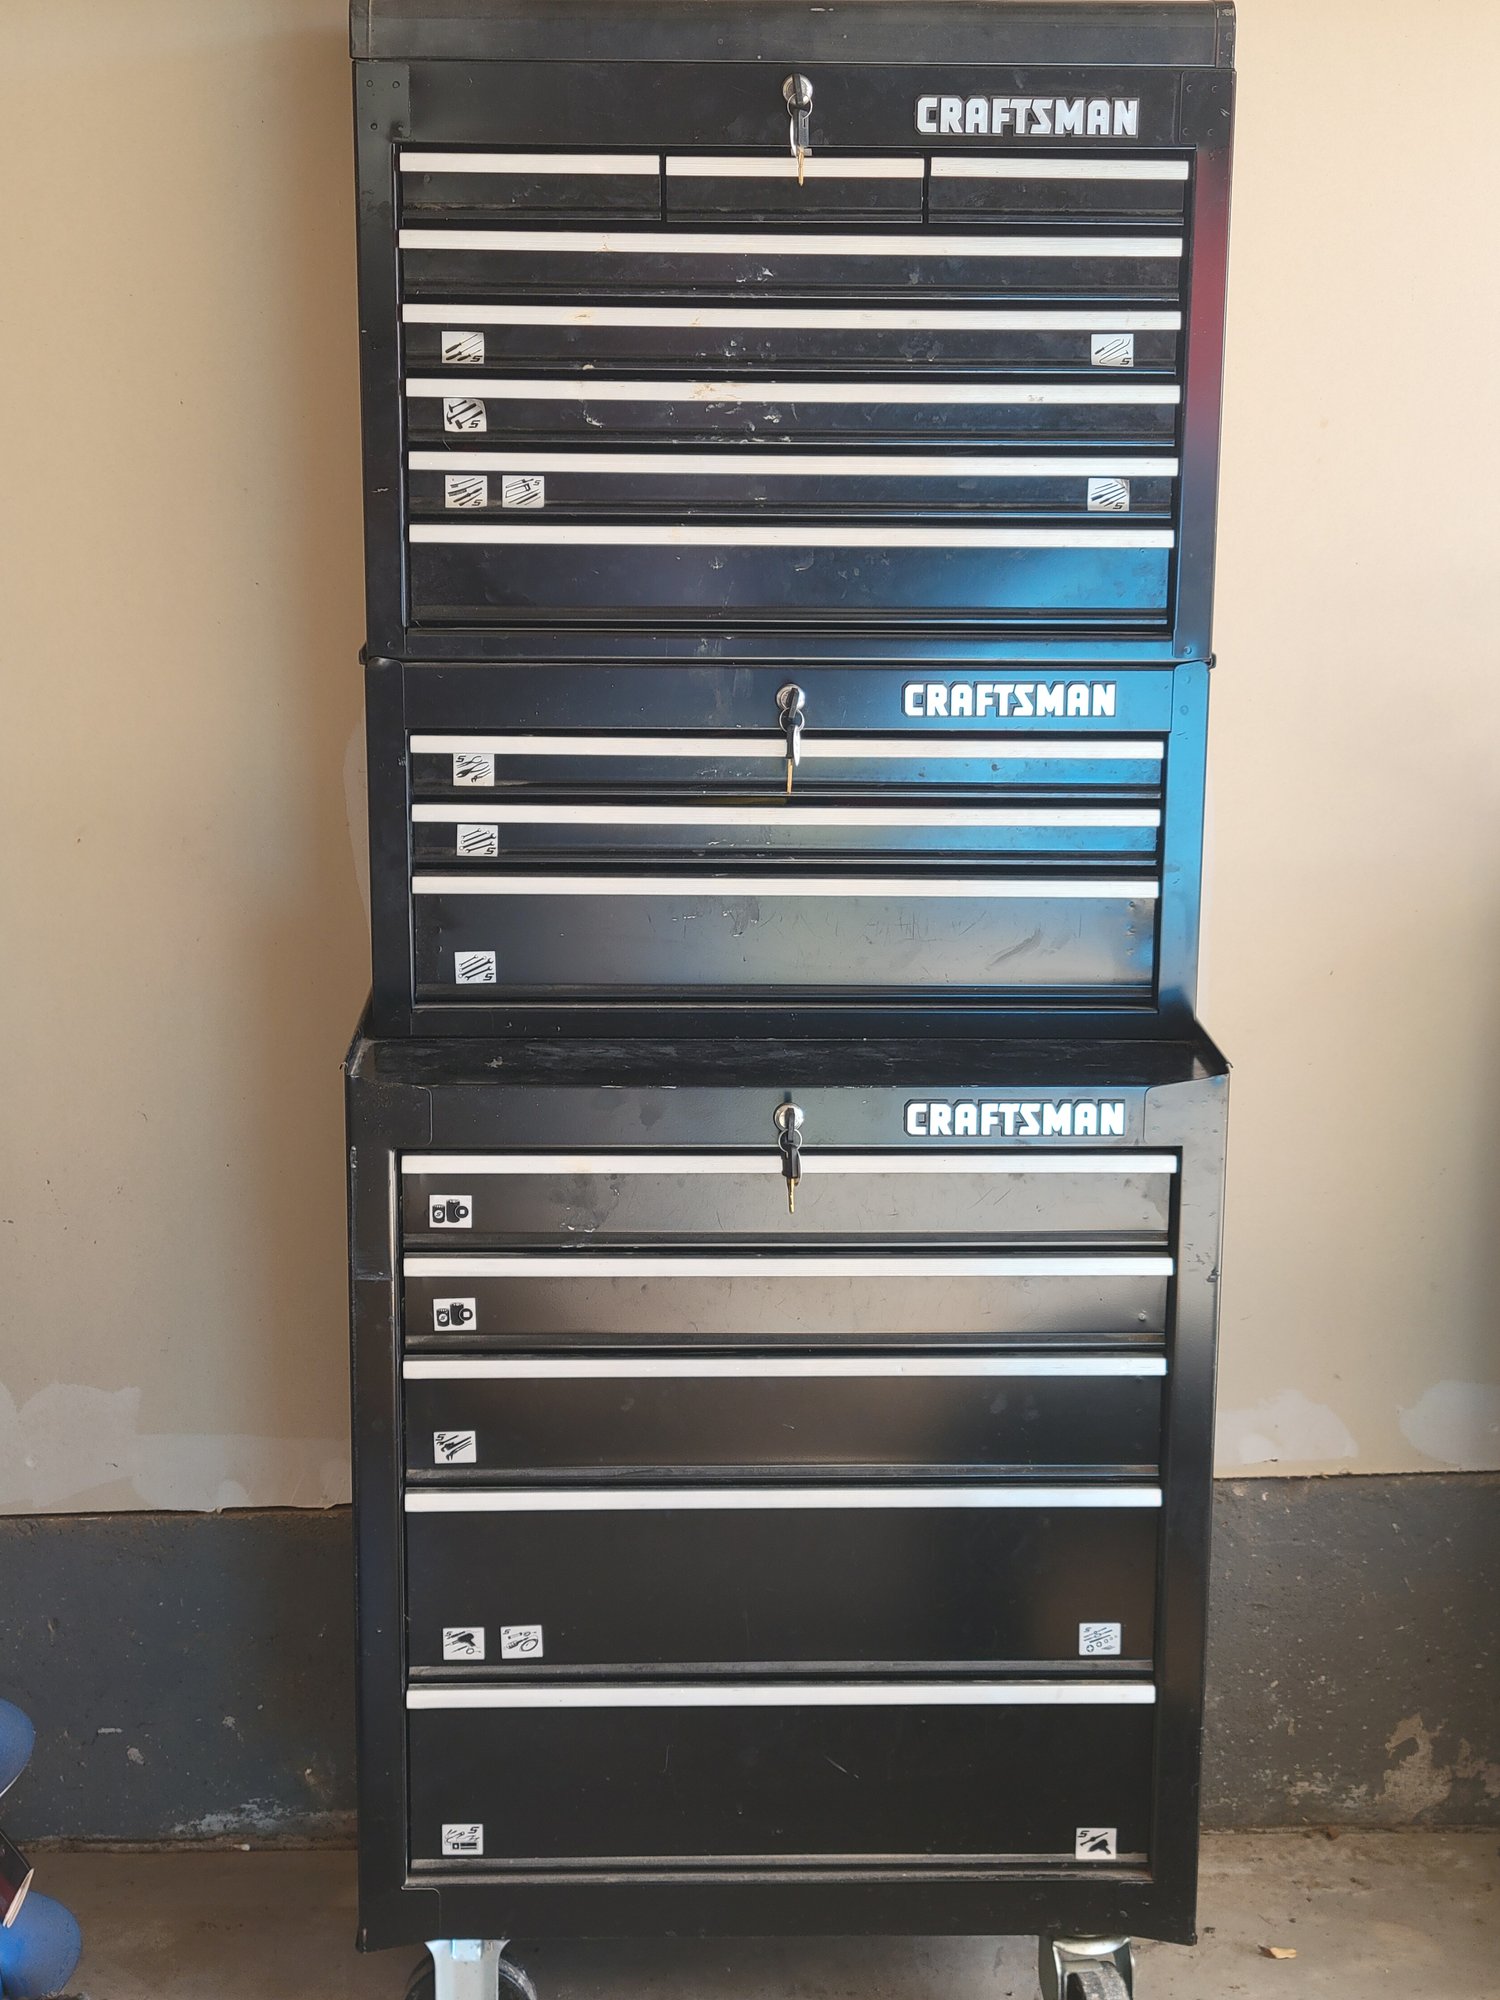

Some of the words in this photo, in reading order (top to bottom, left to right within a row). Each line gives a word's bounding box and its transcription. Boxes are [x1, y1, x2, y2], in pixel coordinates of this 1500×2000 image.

[916, 96, 1138, 137] CRAFTSMAN
[903, 681, 1116, 717] CRAFTSMAN
[906, 1101, 1125, 1136] CRAFTSMAN
